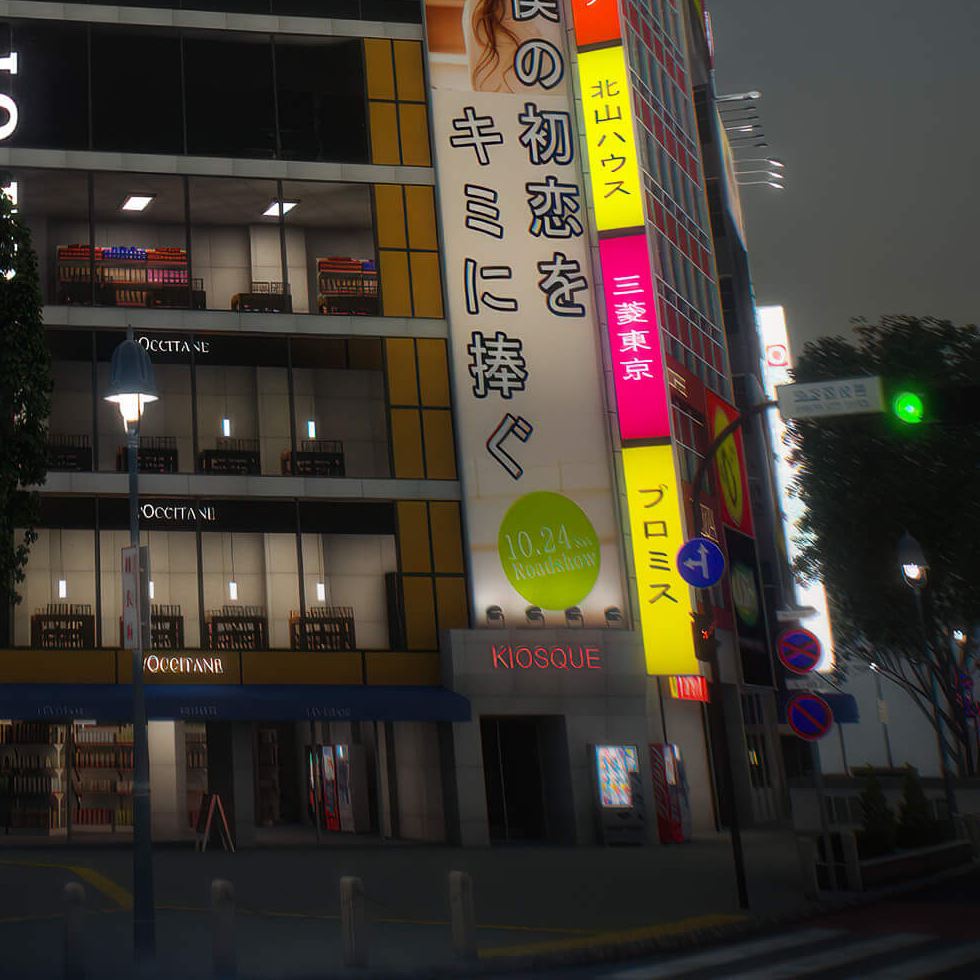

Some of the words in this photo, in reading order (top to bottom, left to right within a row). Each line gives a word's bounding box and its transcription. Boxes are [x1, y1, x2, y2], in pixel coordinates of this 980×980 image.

[590, 78, 630, 199] 北山ハウス
[449, 106, 532, 481] キミに捧ぐ
[612, 274, 654, 381] 三菱東京
[504, 524, 572, 560] 10.24
[492, 644, 602, 670] KIOSQUE
